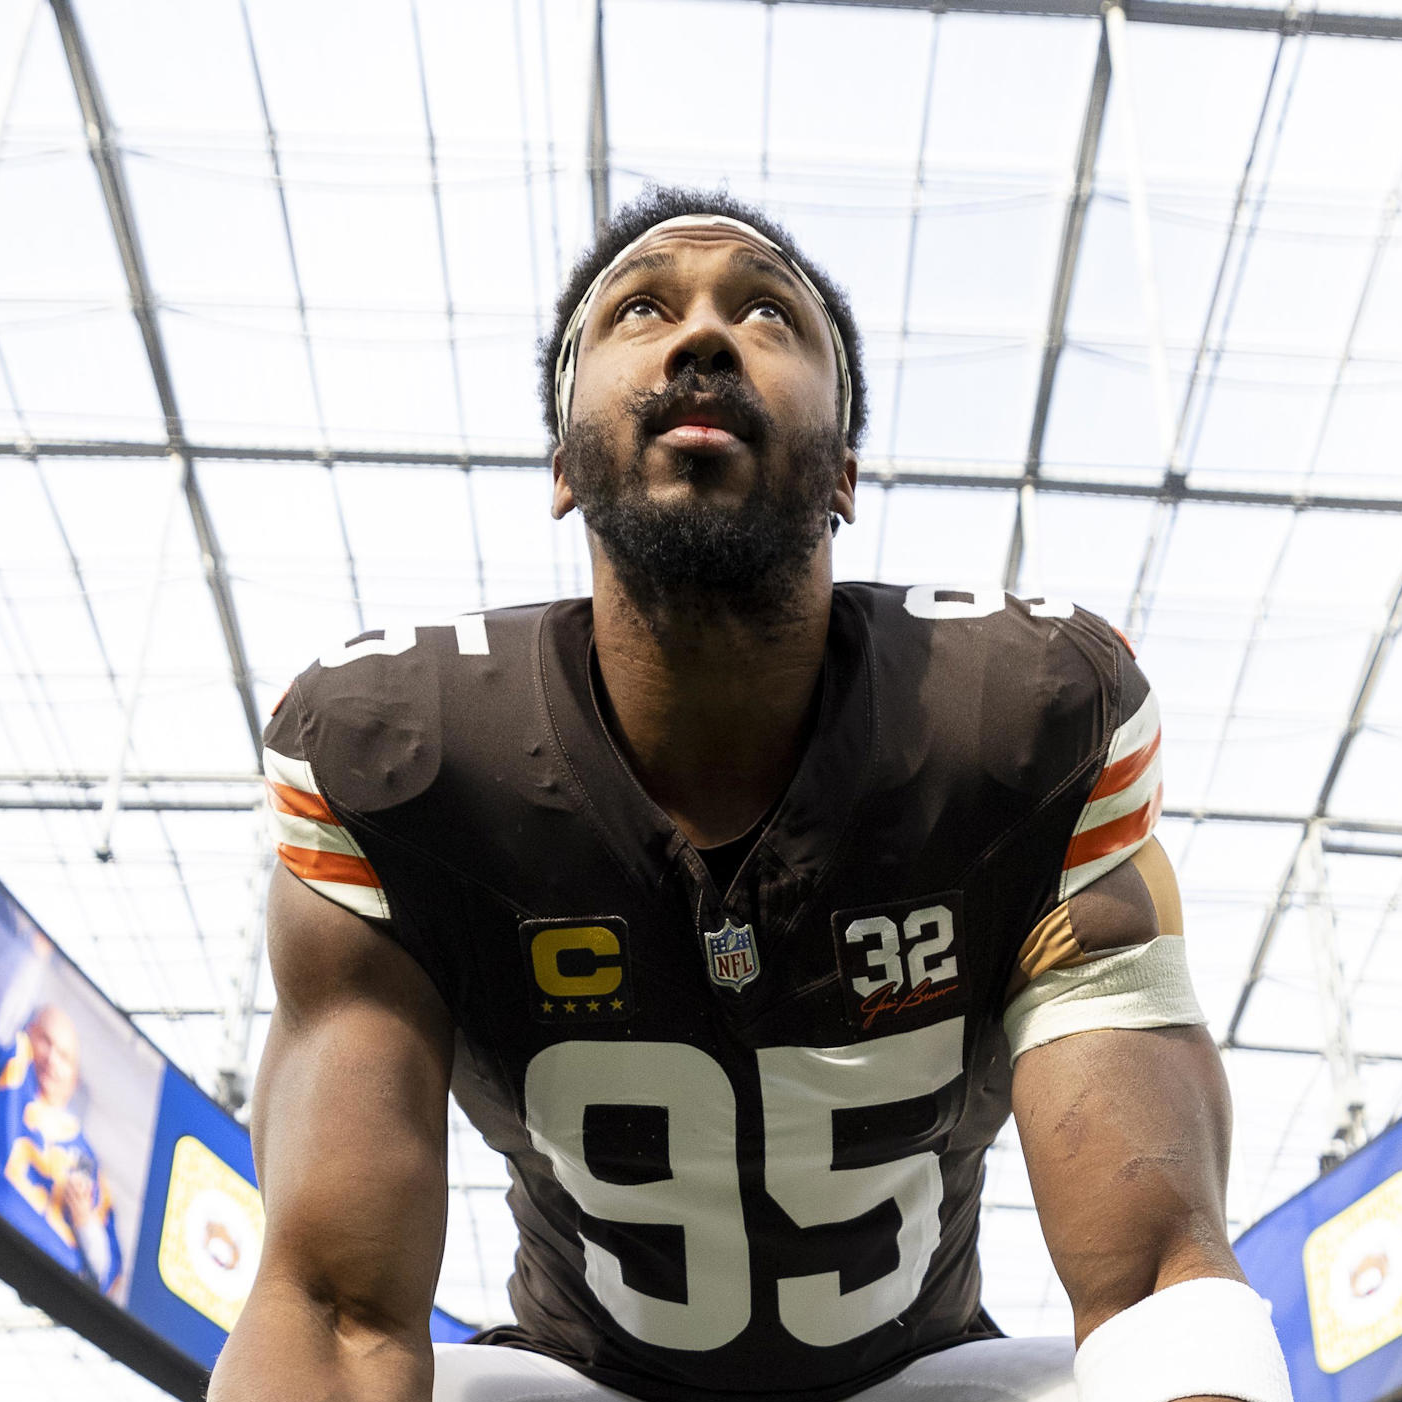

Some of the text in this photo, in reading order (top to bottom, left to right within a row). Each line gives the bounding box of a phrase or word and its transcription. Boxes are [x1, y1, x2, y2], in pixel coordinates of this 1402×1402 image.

[530, 926, 623, 997] C
[716, 951, 753, 979] NFL
[845, 904, 959, 998] 32
[524, 1015, 965, 1352] 95
